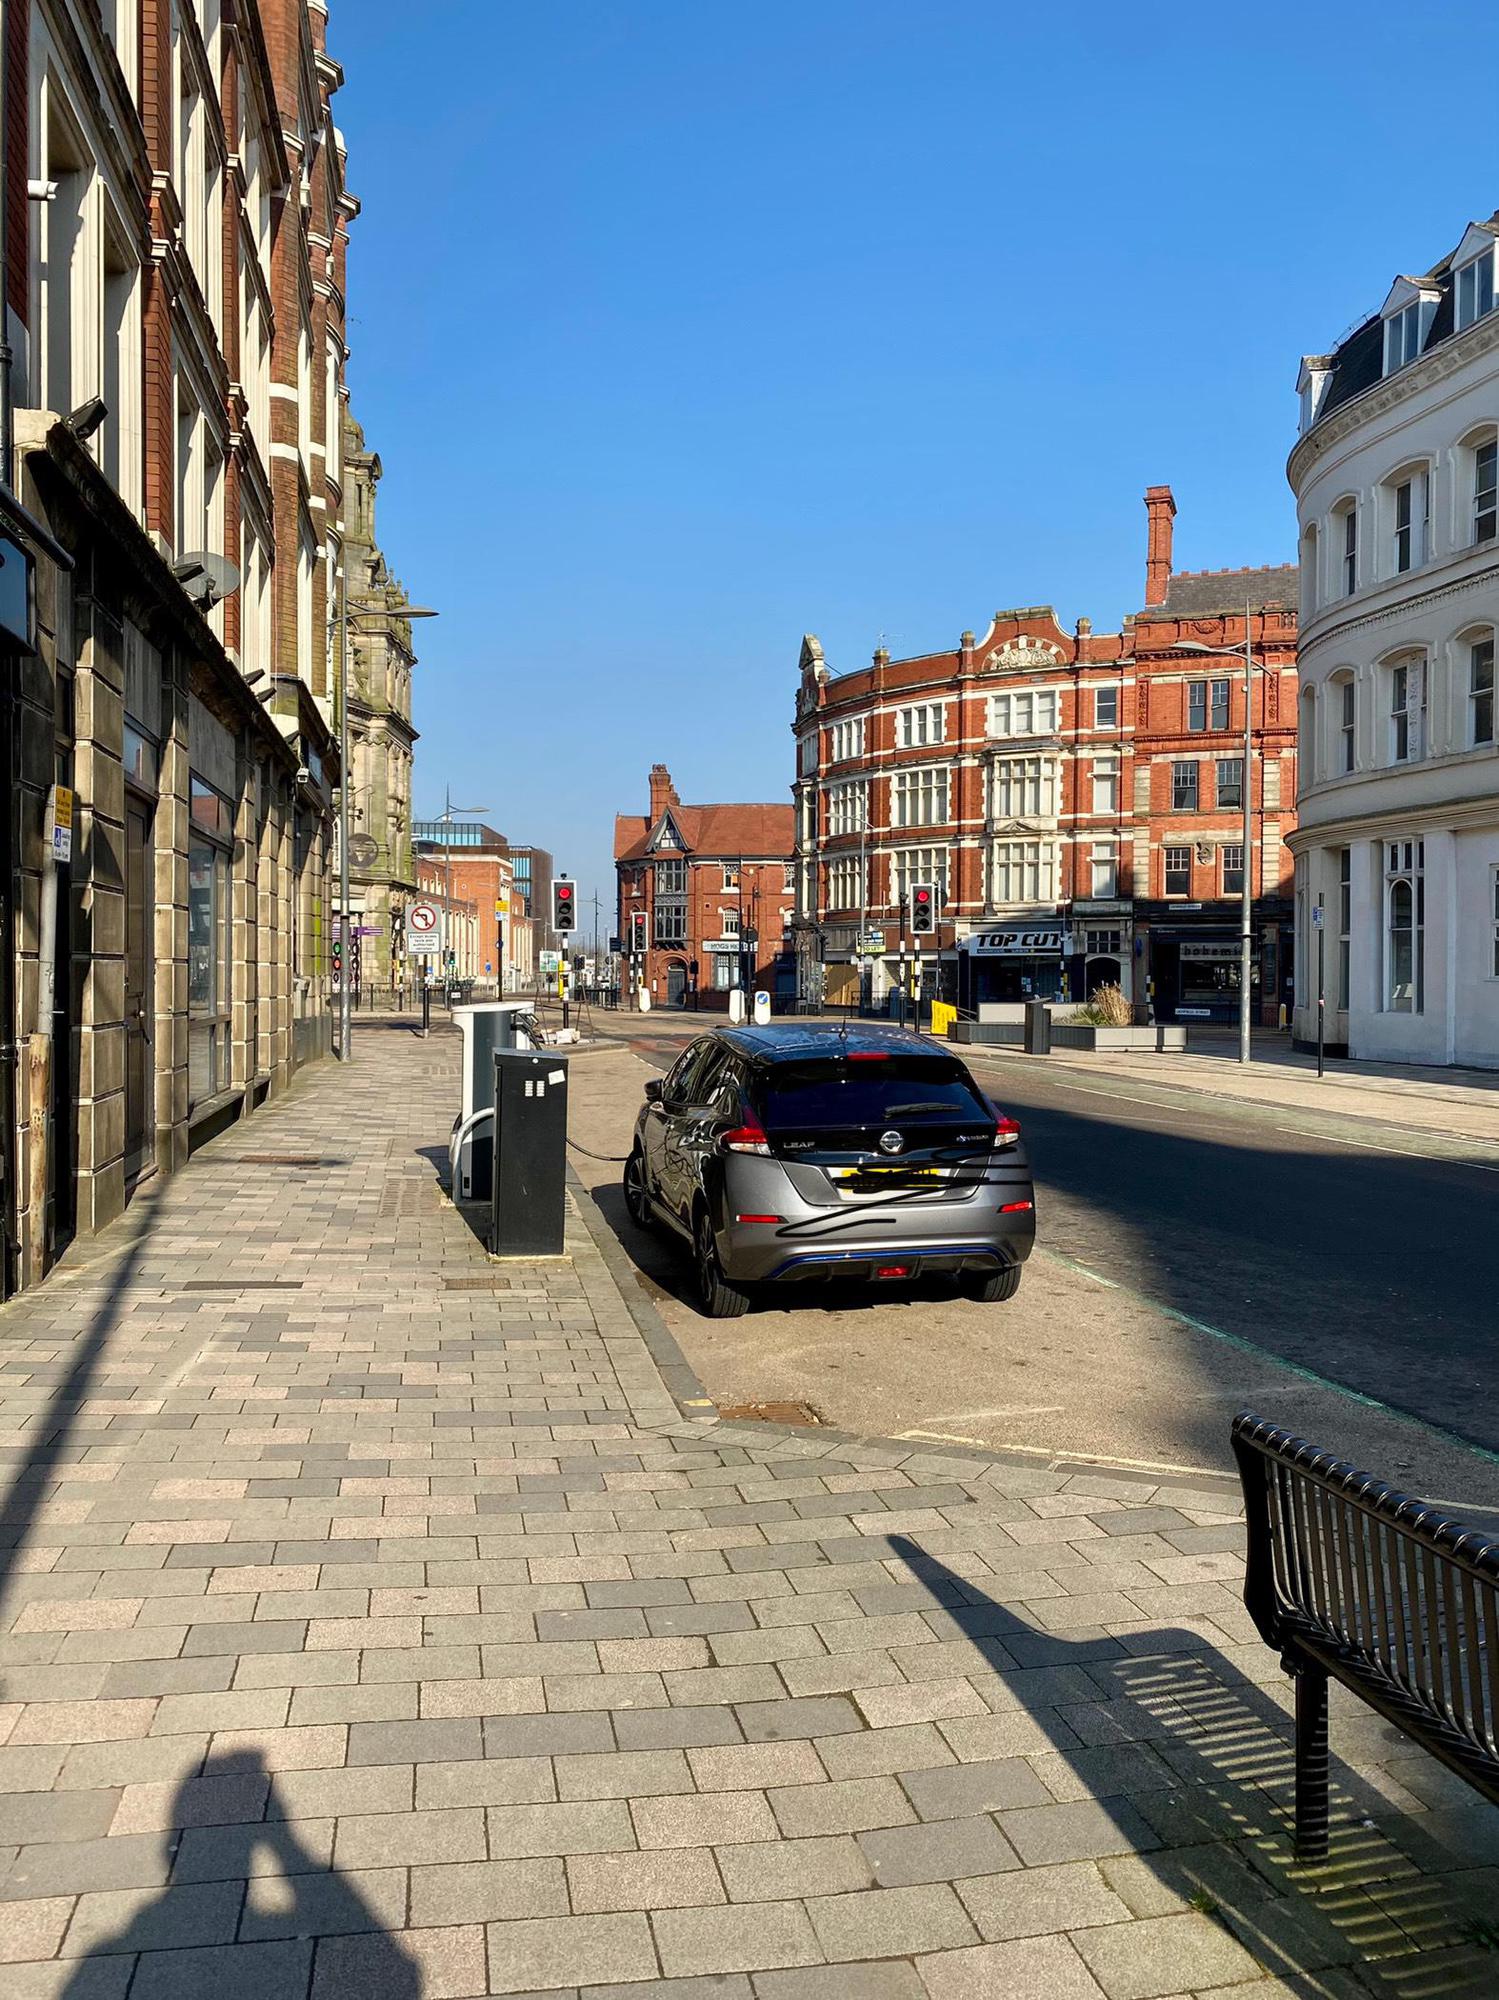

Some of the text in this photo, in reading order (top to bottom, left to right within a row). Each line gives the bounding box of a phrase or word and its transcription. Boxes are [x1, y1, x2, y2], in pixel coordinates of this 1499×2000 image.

[977, 933, 1064, 947] TOP CUT
[1184, 945, 1241, 956] bohemi
[783, 1141, 815, 1149] LEAF
